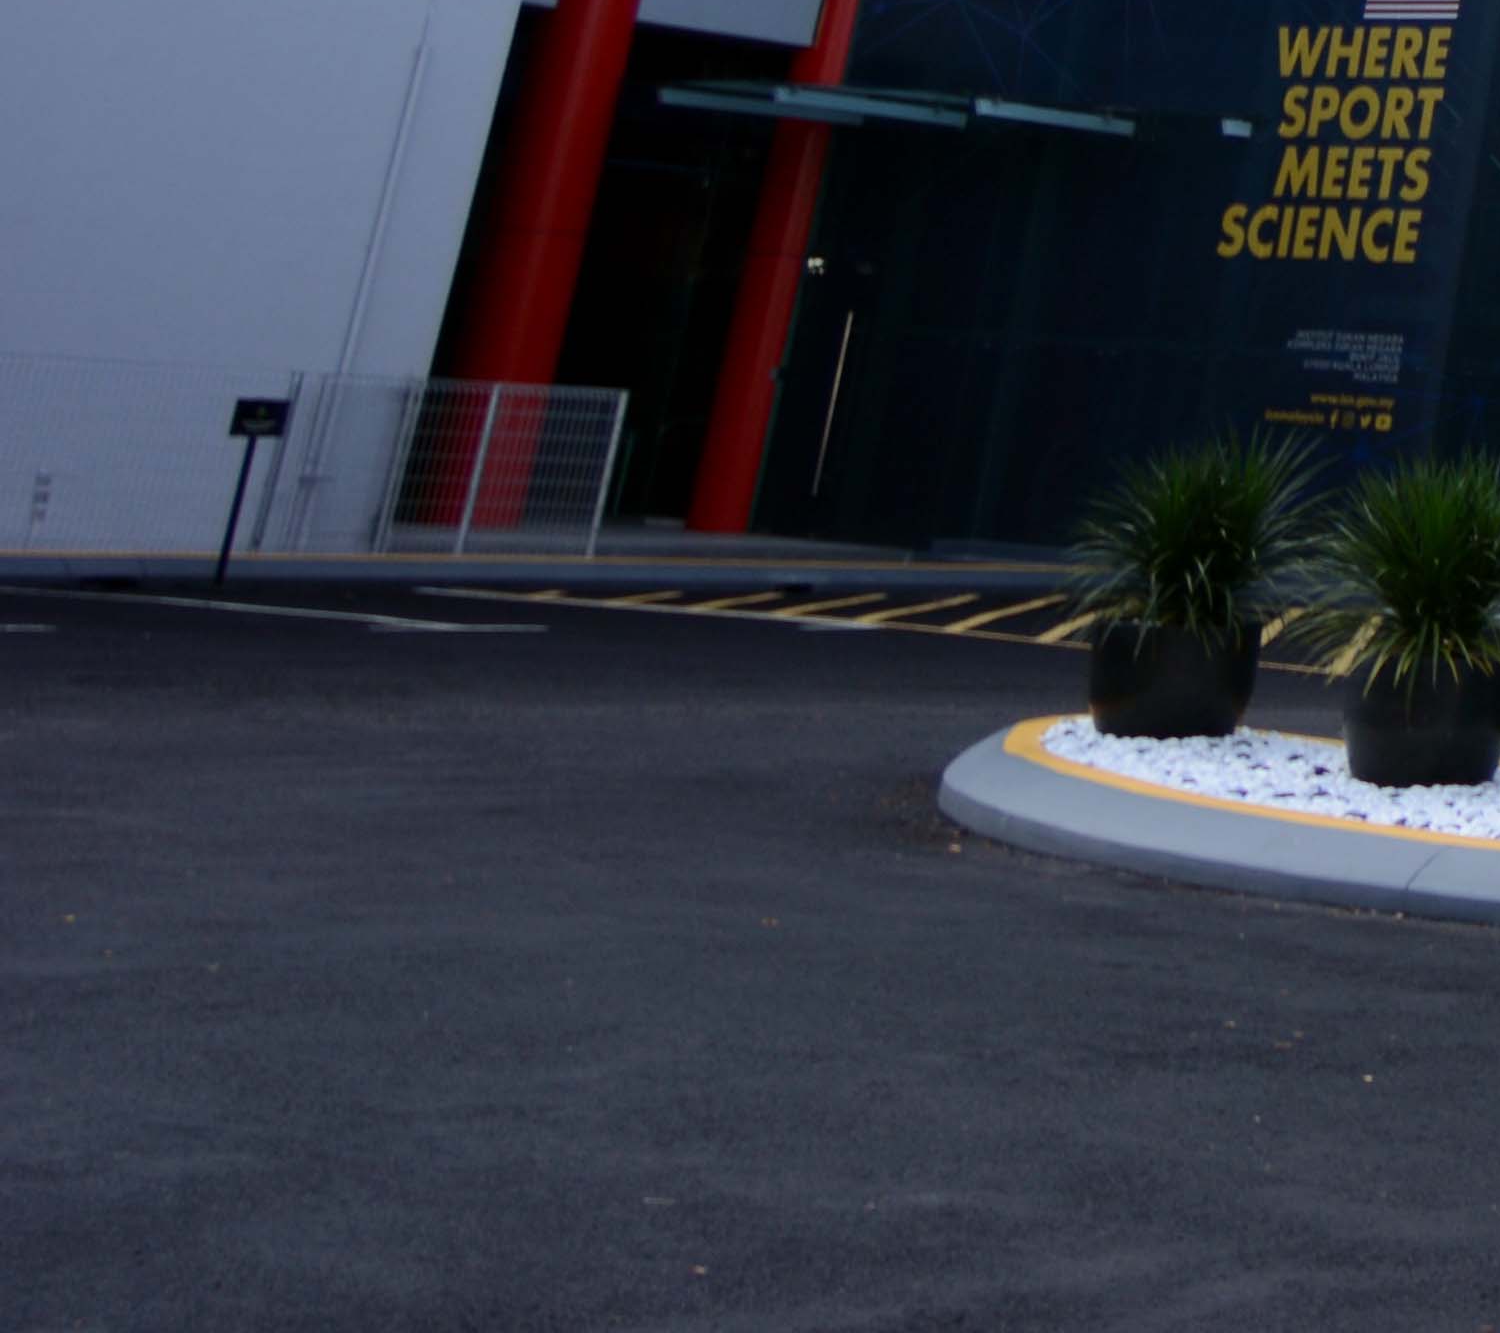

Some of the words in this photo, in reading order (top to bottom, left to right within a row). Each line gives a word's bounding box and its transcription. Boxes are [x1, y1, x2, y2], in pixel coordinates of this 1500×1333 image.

[1277, 25, 1452, 79] WHERE
[1277, 85, 1445, 140] SPORT
[1272, 145, 1432, 201] MEETS
[1216, 203, 1422, 264] SCIENCE
